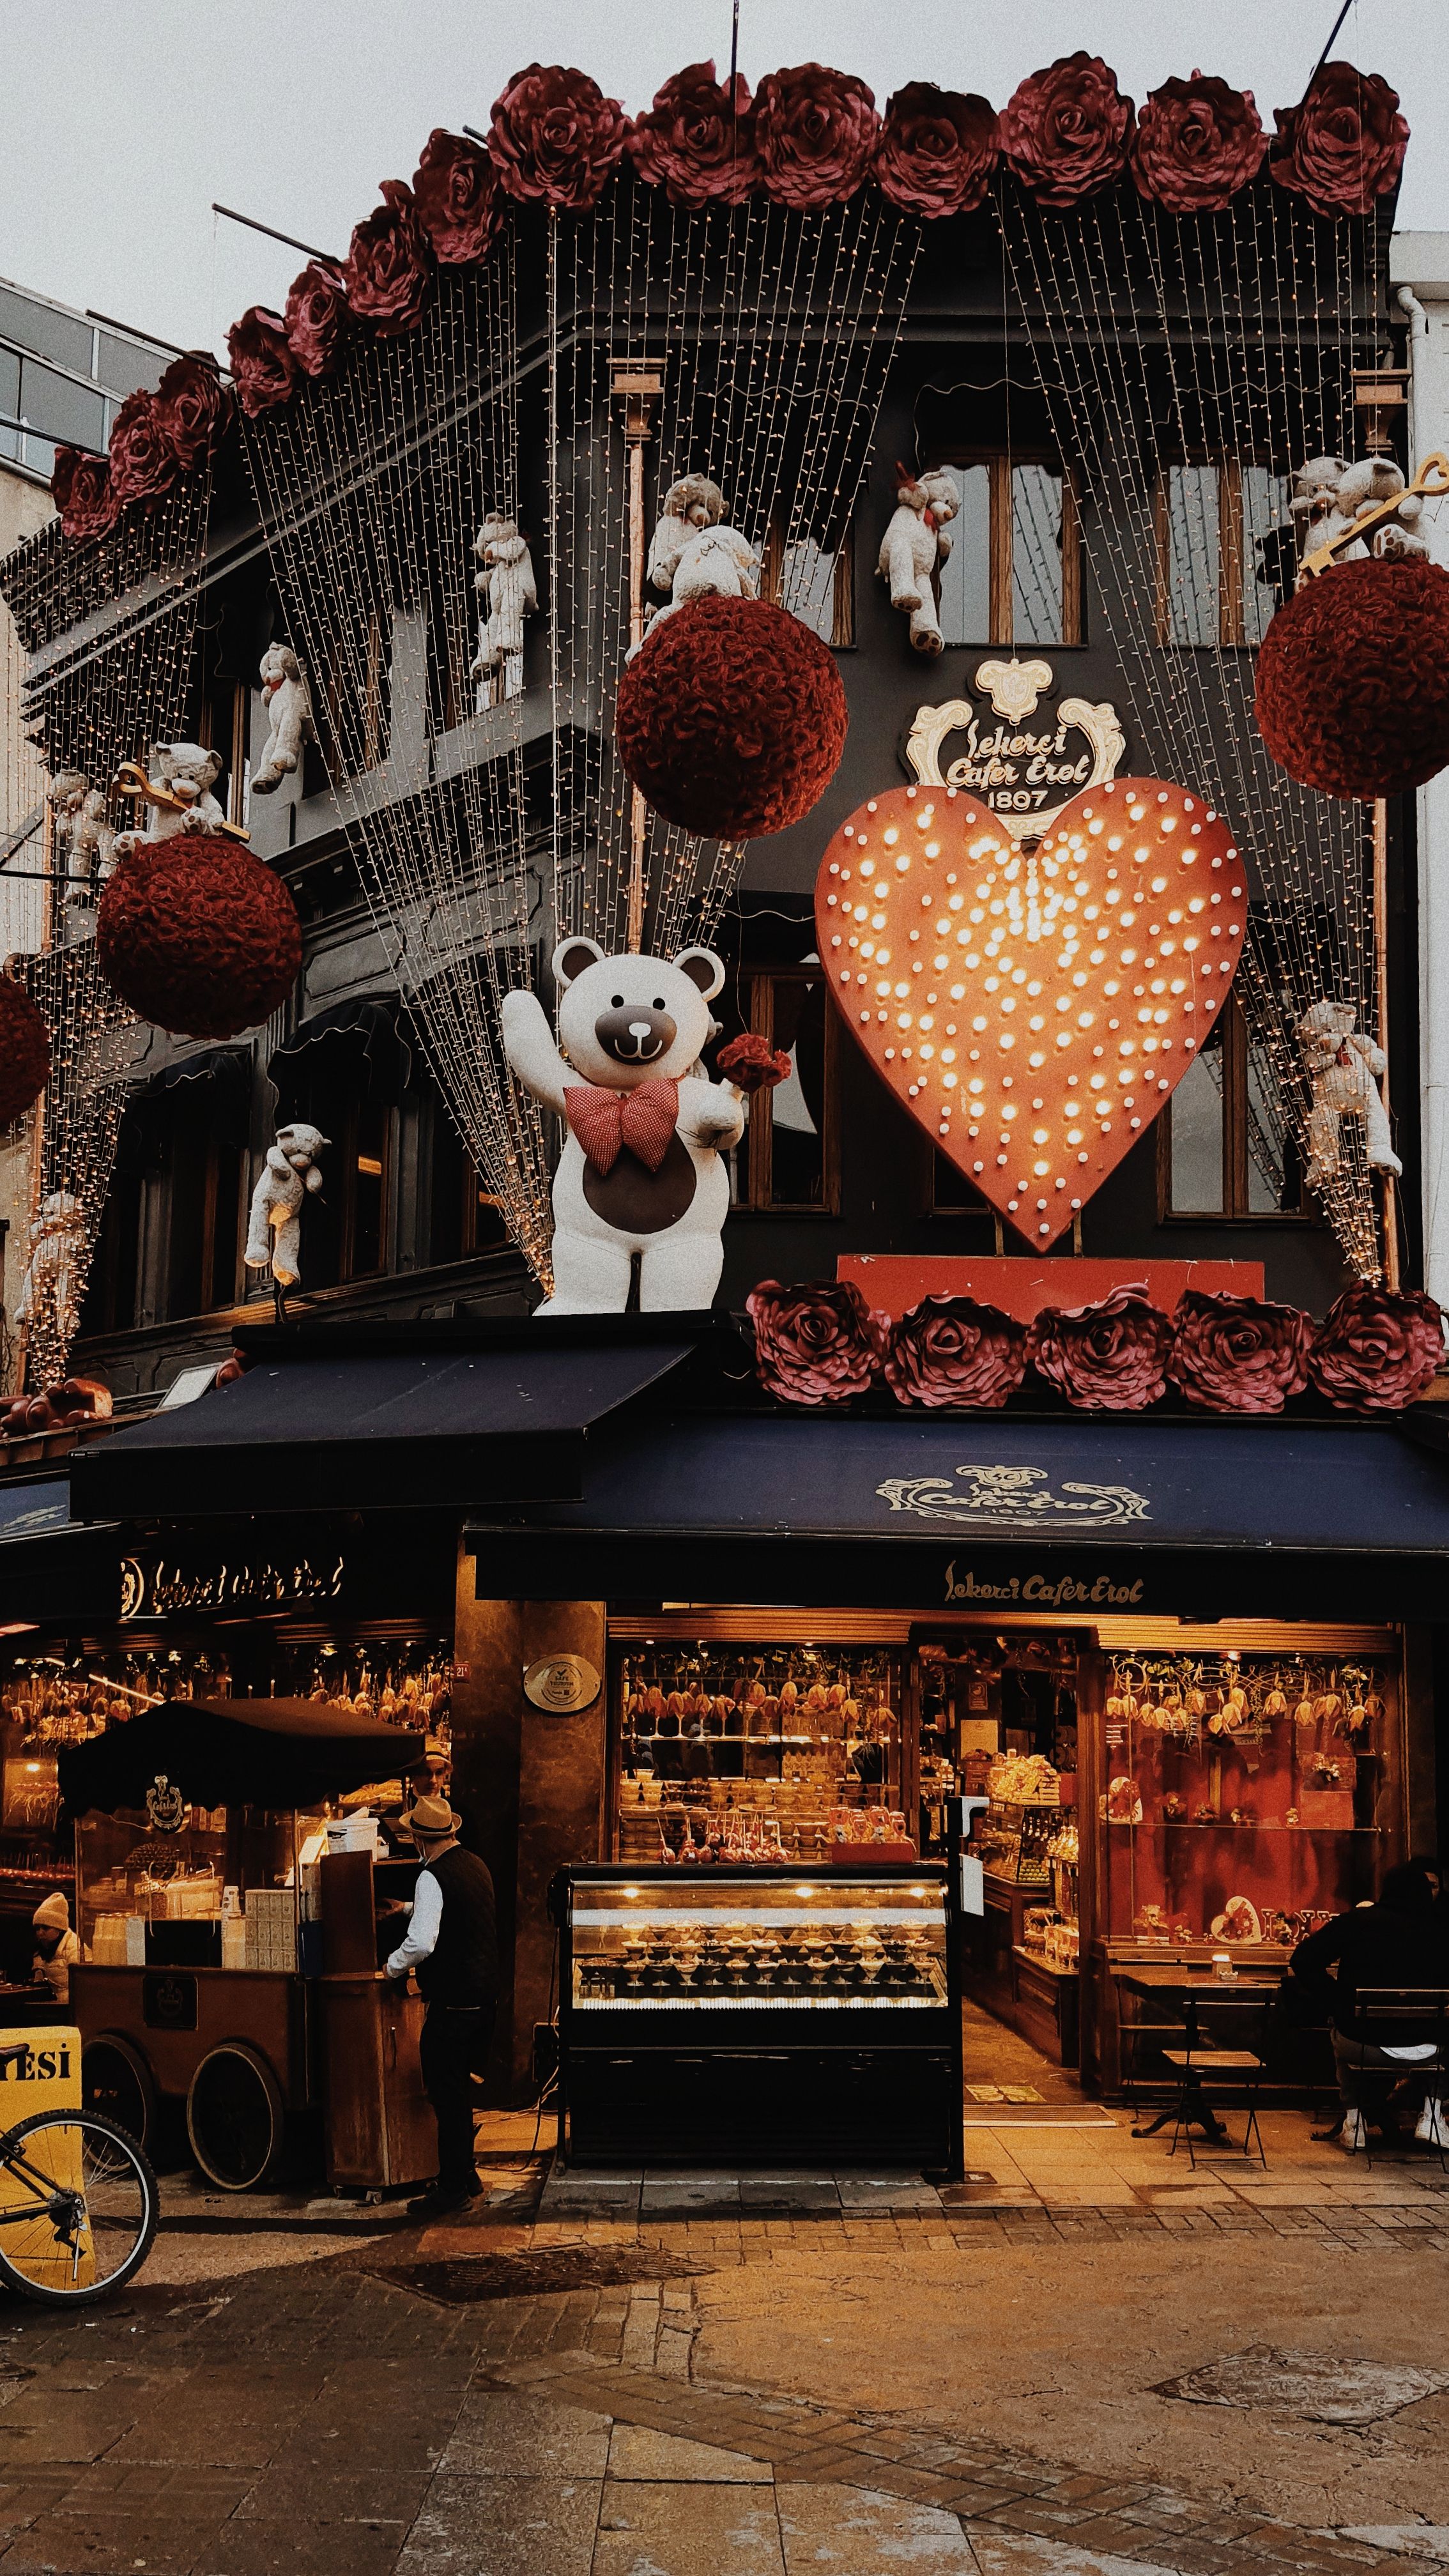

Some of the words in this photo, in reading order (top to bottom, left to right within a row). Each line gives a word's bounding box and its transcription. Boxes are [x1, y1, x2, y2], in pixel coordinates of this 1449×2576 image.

[946, 757, 1020, 791] Cafer
[1025, 755, 1091, 785] Erol
[988, 790, 1048, 811] 1807
[918, 1493, 1026, 1508] Cafer
[1027, 1497, 1111, 1510] Erol
[1022, 1574, 1090, 1607] Cafer
[1090, 1575, 1144, 1604] Erol
